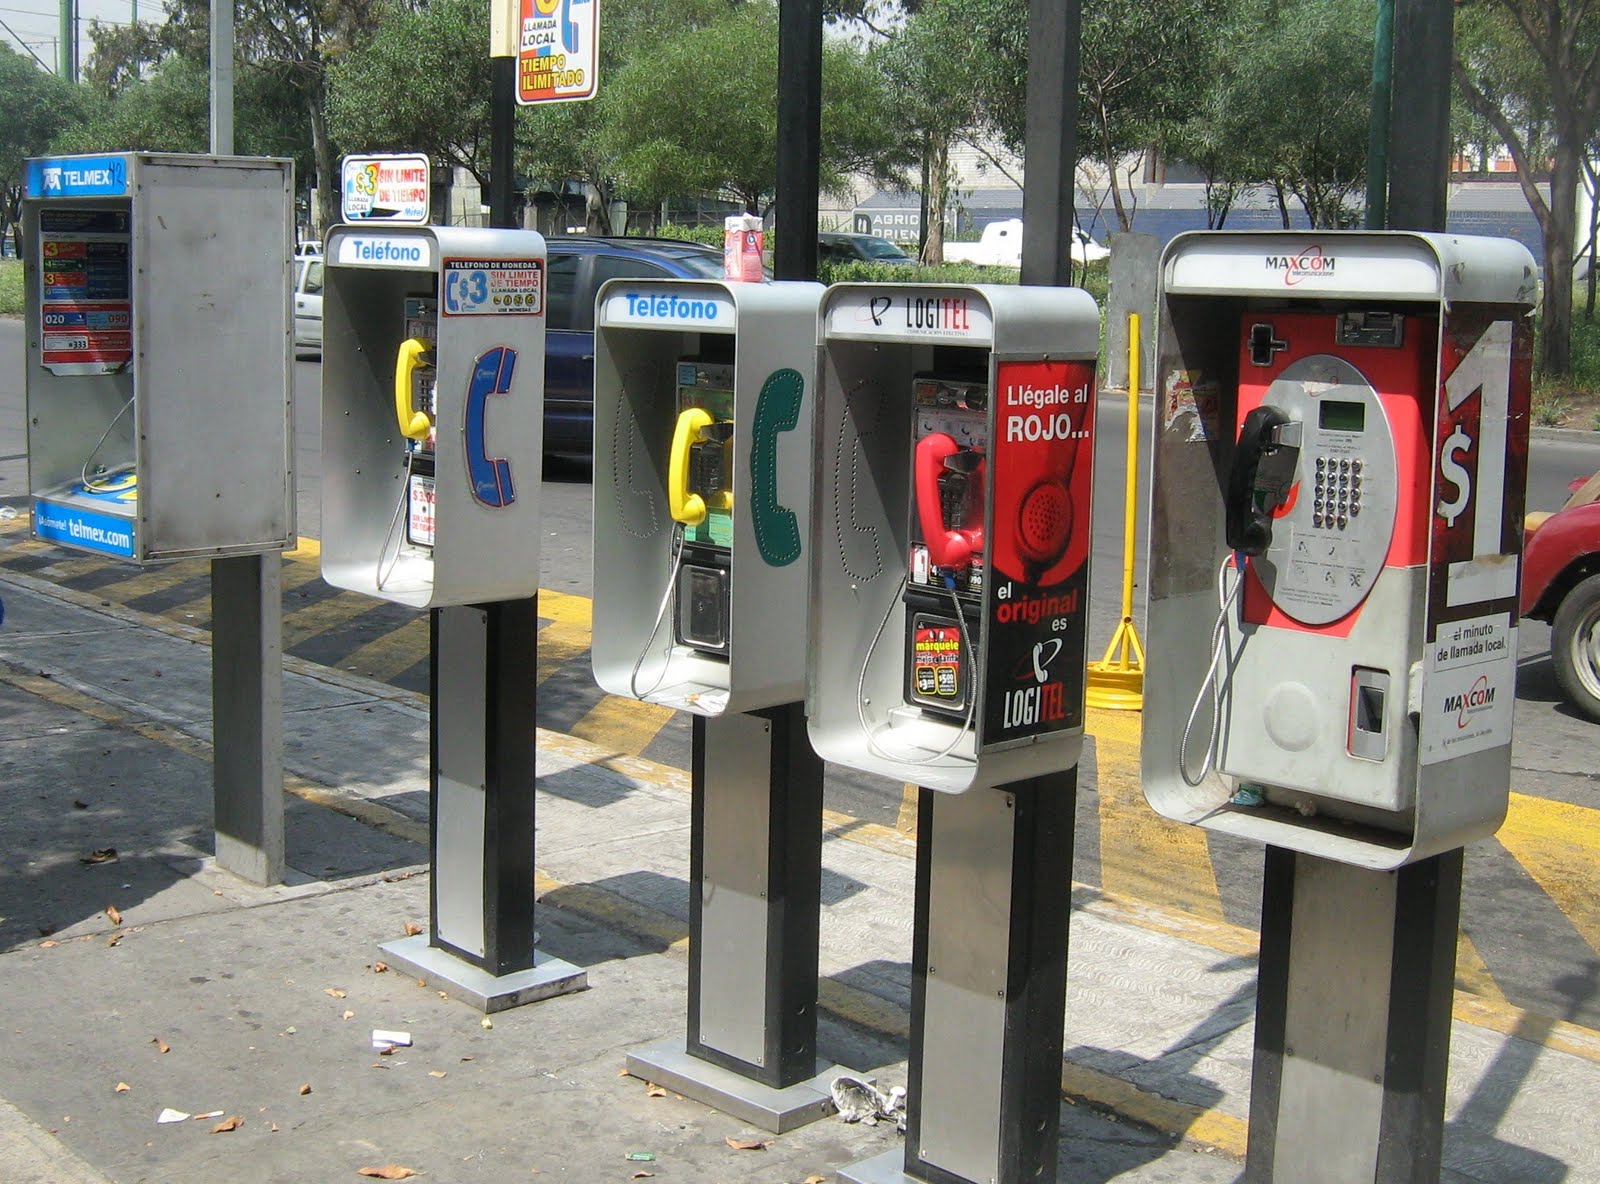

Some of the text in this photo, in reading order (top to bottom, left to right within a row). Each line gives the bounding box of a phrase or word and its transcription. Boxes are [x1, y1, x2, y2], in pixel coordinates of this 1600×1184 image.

[524, 20, 557, 32] LLAMADA
[523, 32, 556, 46] LOCAL
[521, 54, 566, 73] TIEMPO
[522, 69, 584, 91] ILIMITADO
[63, 170, 111, 186] TELMEX
[379, 168, 425, 183] SIN LIMITE
[379, 188, 425, 203] DE TIEMPO
[348, 203, 368, 212] LOCAL
[353, 240, 421, 261] Teléfono
[1265, 256, 1335, 270] MAXCOM
[490, 271, 538, 279] SIN LIMITE
[626, 293, 718, 320] Teléfono
[906, 298, 969, 330] LOGITEL
[45, 314, 65, 324] 020
[1007, 383, 1089, 409] Llégale al
[1007, 414, 1089, 442] ROJO...
[68, 518, 130, 548] telmex.com
[997, 582, 1012, 600] el
[997, 589, 1078, 624] original
[1051, 618, 1068, 631] es
[1454, 623, 1494, 641] el minuto
[916, 640, 959, 653] márquele
[1437, 647, 1449, 661] de
[1450, 641, 1483, 660] llamada
[1003, 683, 1065, 729] LOGITEL
[1443, 687, 1496, 713] MAXCOM
